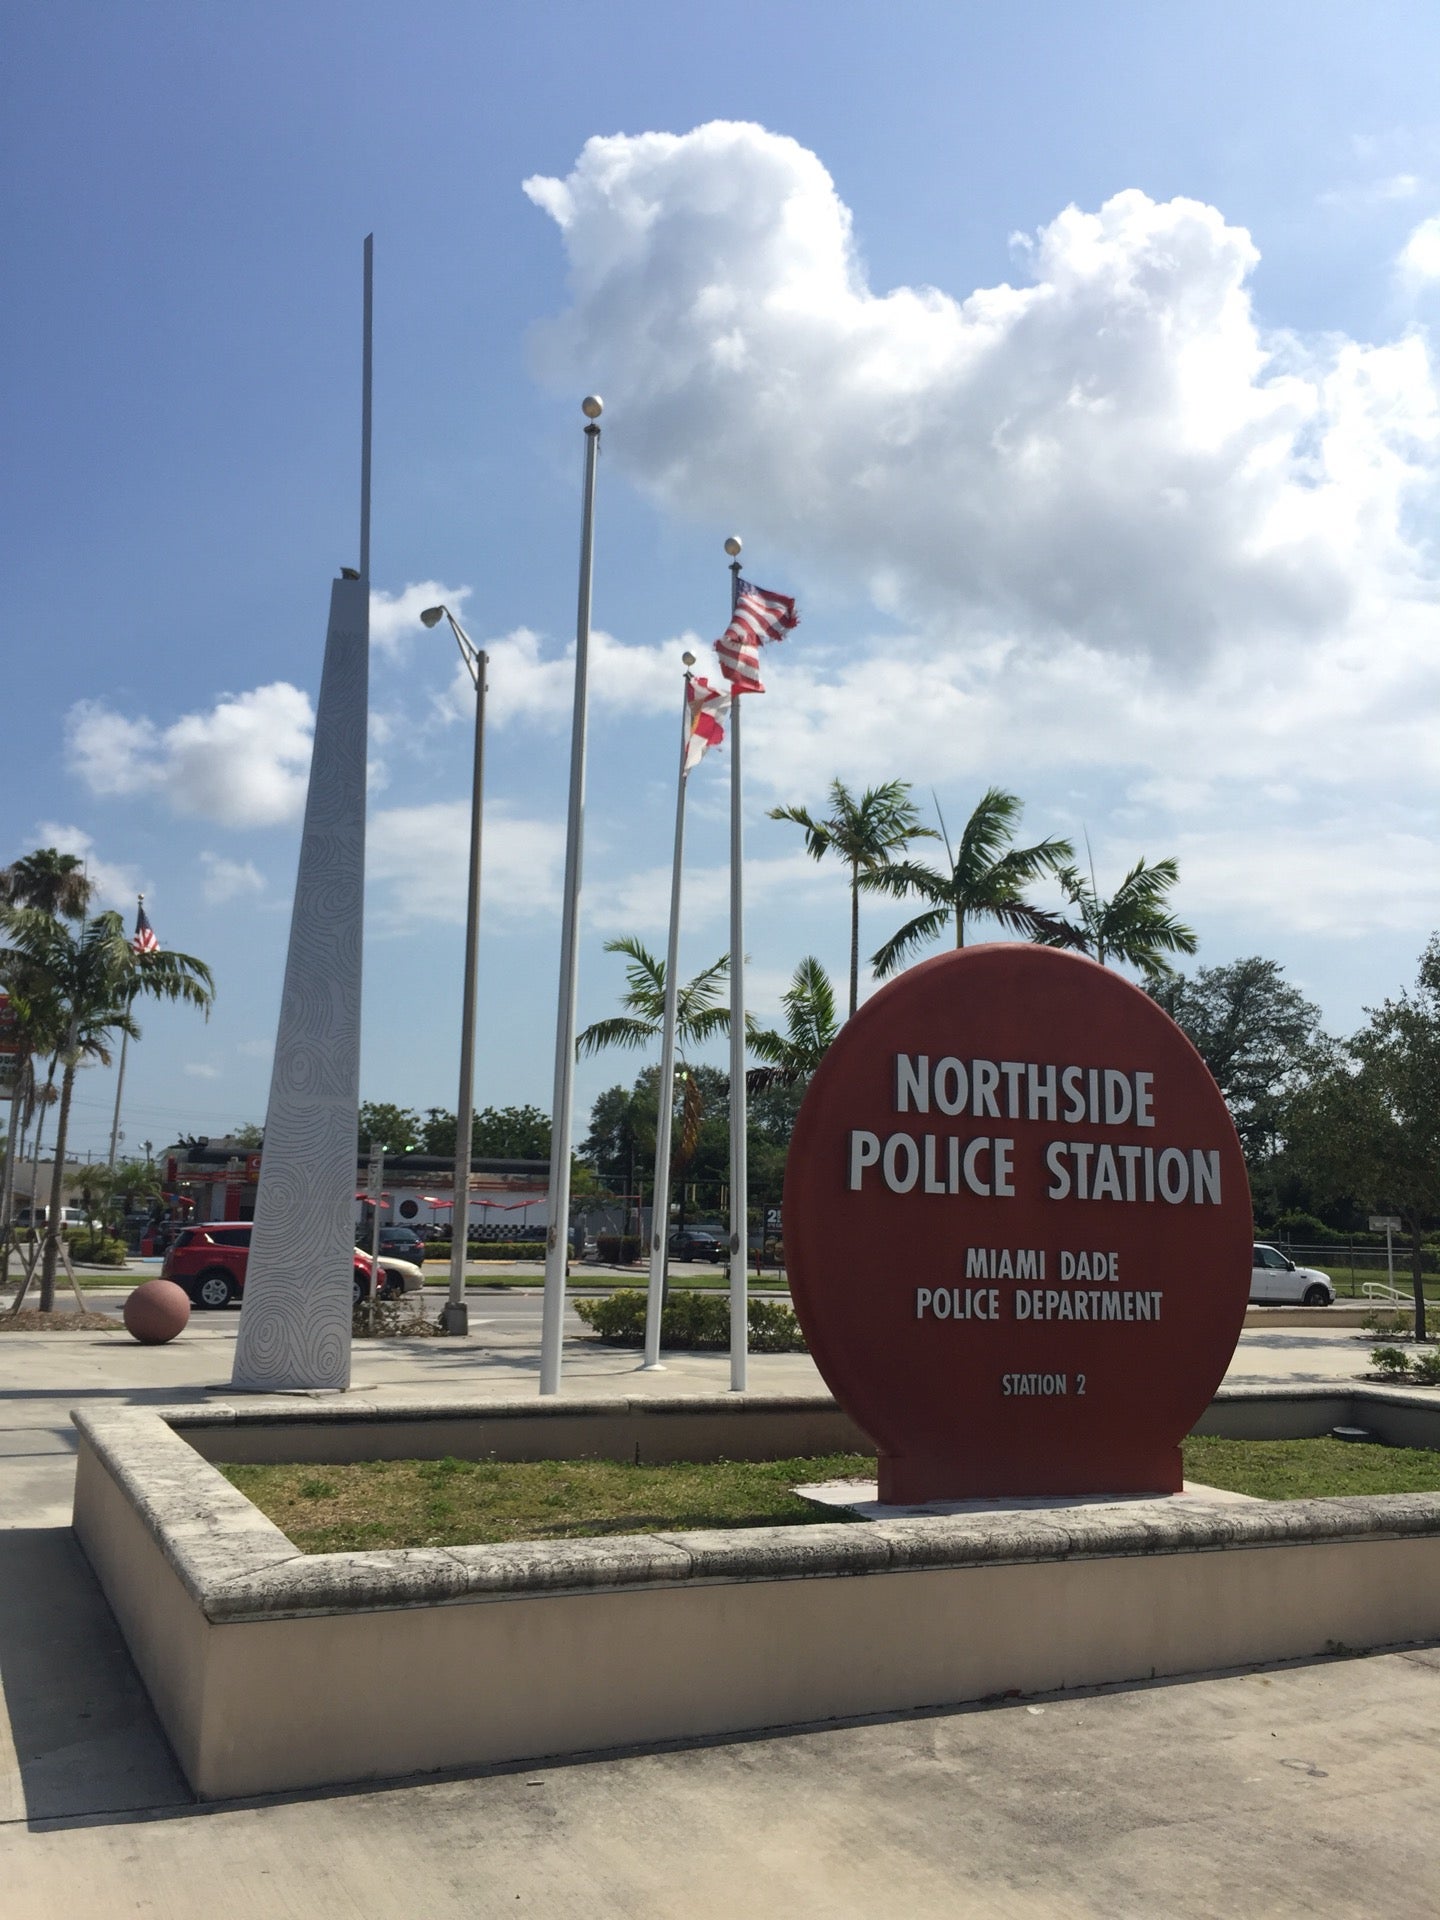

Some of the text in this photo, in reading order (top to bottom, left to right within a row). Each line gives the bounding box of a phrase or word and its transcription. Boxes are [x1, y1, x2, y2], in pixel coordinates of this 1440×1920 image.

[896, 1053, 1156, 1128] NORTHSIDE
[849, 1130, 1222, 1205] POLICE STATION
[965, 1248, 1119, 1282] MIAMI DADE
[916, 1287, 1163, 1321] POLICE DEPARTMENT
[1001, 1374, 1087, 1396] STATION 2
